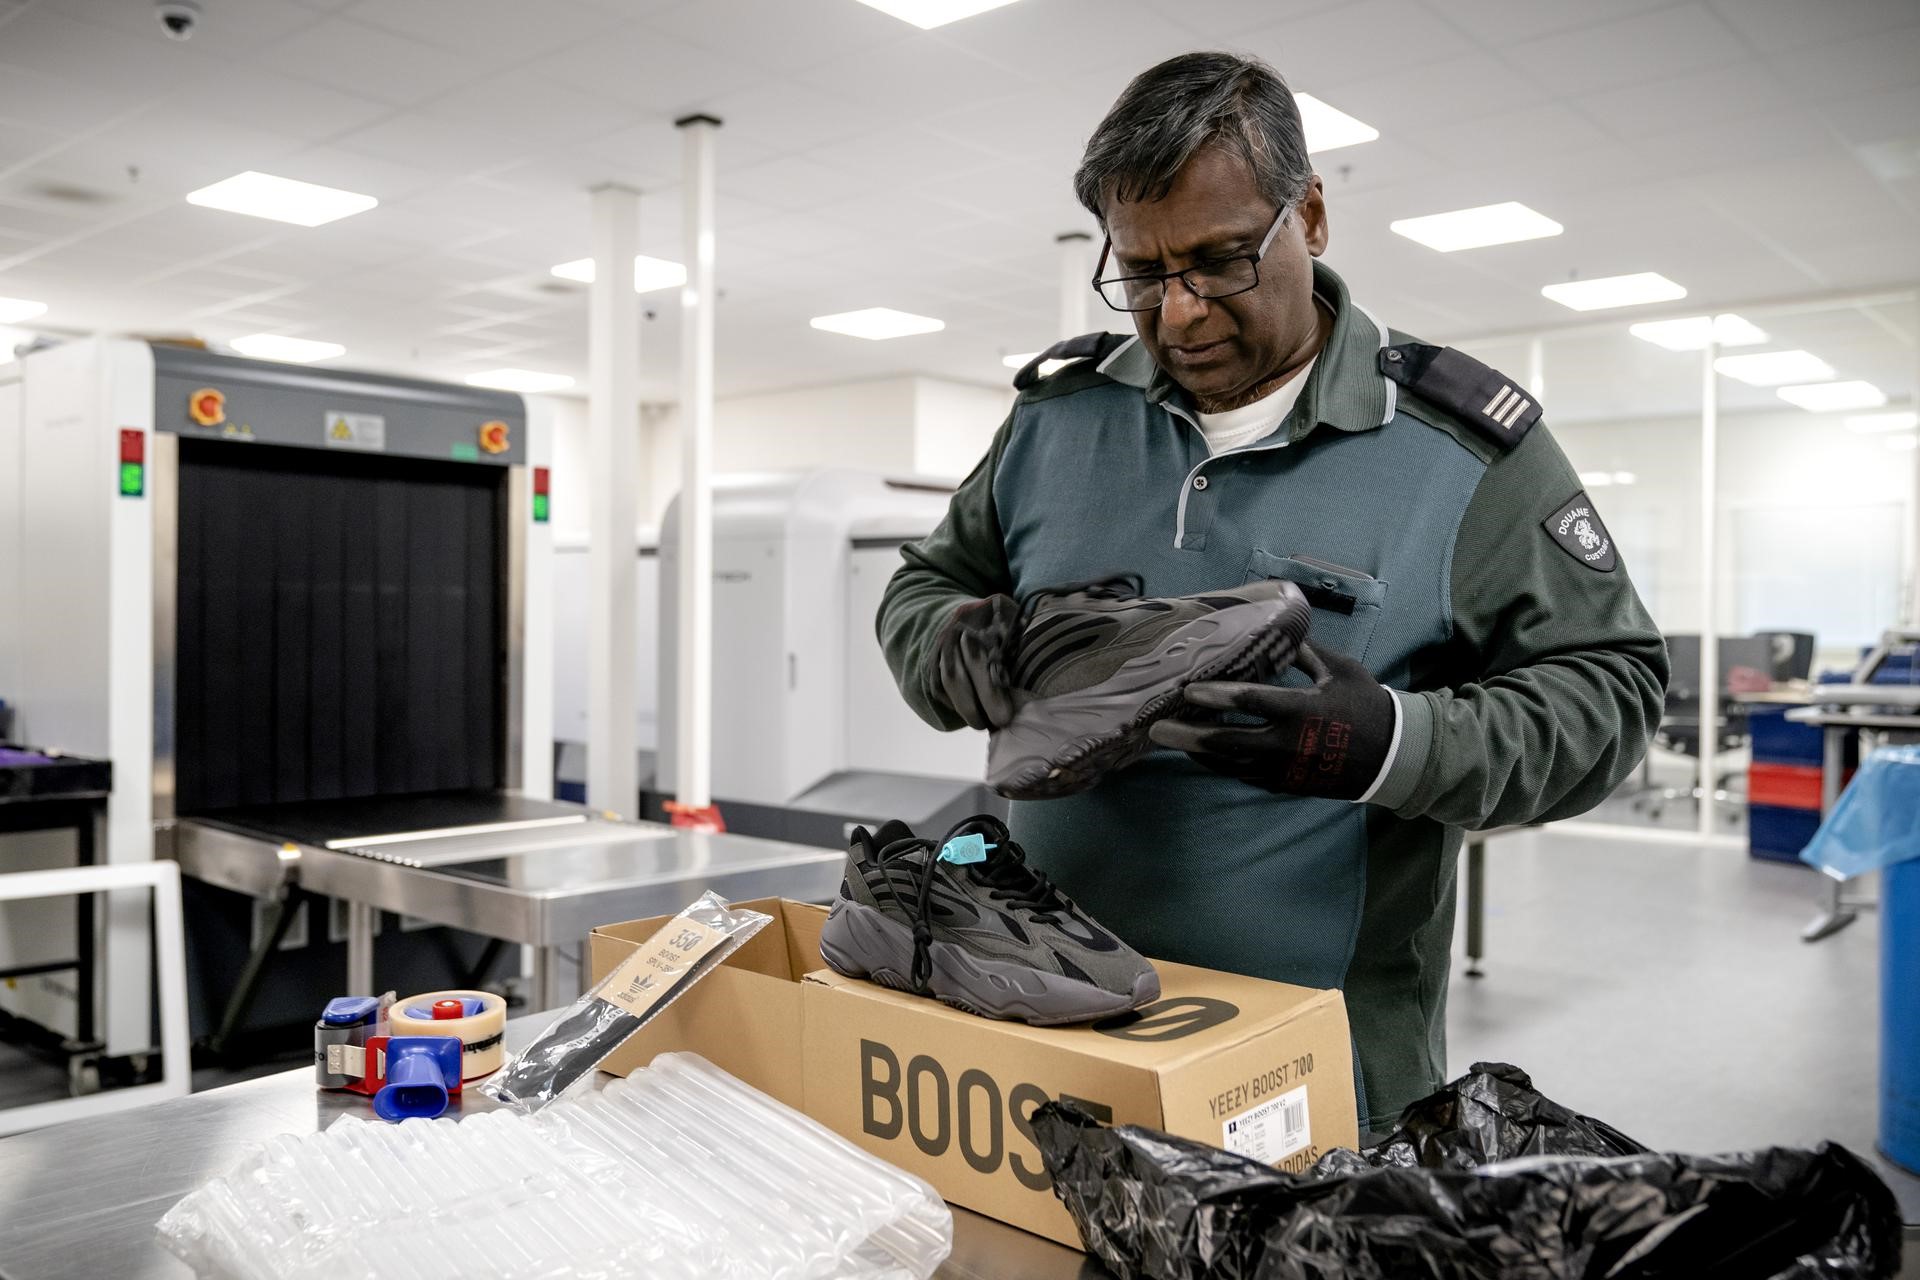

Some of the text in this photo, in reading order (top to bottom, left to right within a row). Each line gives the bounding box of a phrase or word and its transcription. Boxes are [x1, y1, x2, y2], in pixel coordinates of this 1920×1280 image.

[1558, 507, 1590, 535] DOUANE
[1584, 538, 1609, 561] CUSTOMS
[668, 928, 703, 952] 350
[658, 948, 681, 962] BOOST
[1208, 1052, 1315, 1120] YEEZY BOOST 700
[860, 1037, 1113, 1192] BOOS
[1277, 1145, 1319, 1175] DIDAS
